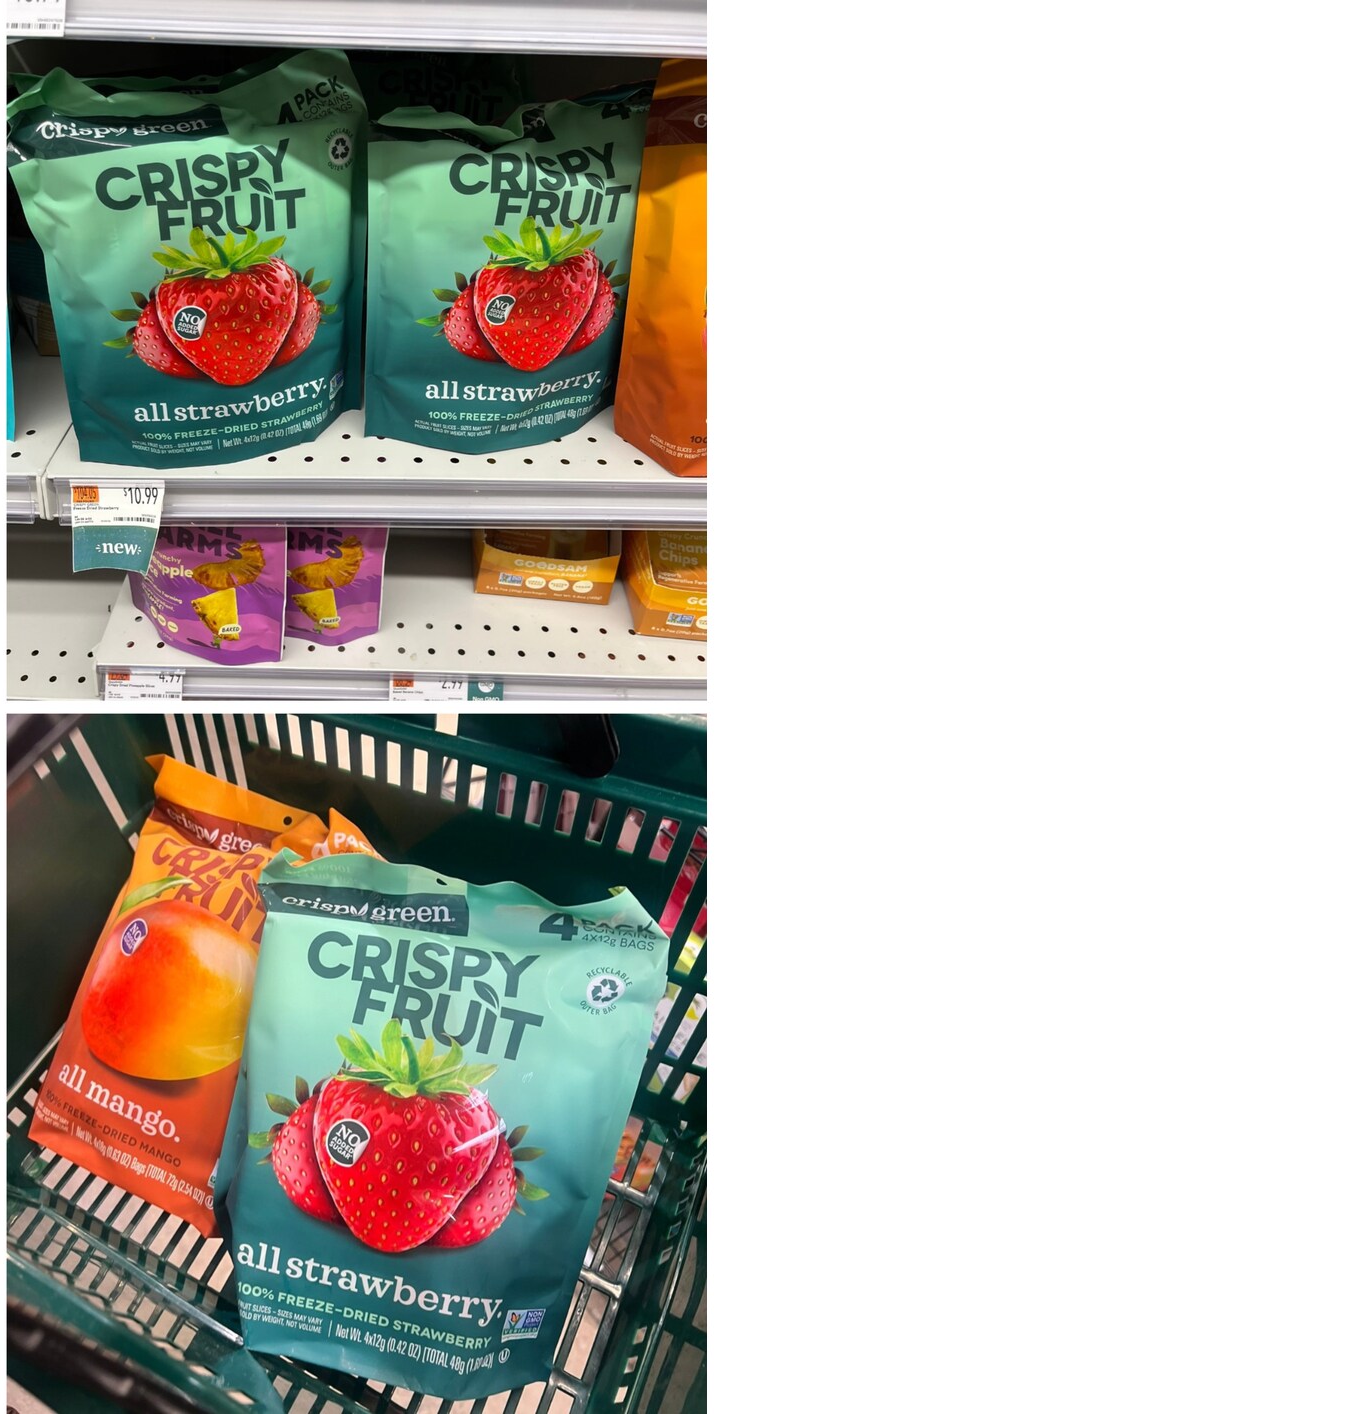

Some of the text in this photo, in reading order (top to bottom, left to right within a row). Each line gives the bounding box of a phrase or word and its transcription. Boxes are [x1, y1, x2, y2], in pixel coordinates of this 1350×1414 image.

[294, 75, 344, 111] PACK
[95, 138, 290, 210] CRISPY
[449, 142, 615, 195] CRISPY
[156, 188, 306, 241] FRUIT
[494, 184, 631, 228] FRUIT
[179, 311, 200, 325] NO
[492, 299, 510, 311] NO
[134, 402, 171, 422] all
[174, 377, 327, 422] strawberry.
[425, 370, 601, 402] all strawberry.
[142, 432, 172, 440] 100%
[261, 401, 323, 429] STRAWBERRY
[428, 411, 457, 420] 100%
[535, 394, 594, 412] STRAWBERRY
[123, 487, 158, 505] $10.99
[102, 541, 138, 555] new
[659, 549, 698, 566] Chips
[539, 913, 579, 941] 4
[620, 939, 654, 951] BAGS
[307, 931, 541, 998] CRISPY
[586, 967, 633, 987] RECYCLABLE
[352, 976, 544, 1061] FRUIT
[580, 1000, 617, 1016] OUTER BAG
[58, 1063, 87, 1094] all
[85, 1080, 181, 1143] mango.
[332, 1136, 354, 1154] ADDED
[336, 1124, 360, 1147] NO
[139, 1142, 181, 1168] MANGO
[166, 1173, 178, 1191] 72g
[237, 1242, 503, 1327] all strawberry.
[238, 1281, 274, 1300] 100%
[392, 1320, 492, 1350] STRAWBERRY
[252, 1303, 323, 1326] SLICES SIZES MAY VARY
[253, 1313, 261, 1321] BY
[285, 1320, 297, 1329] NOT
[298, 1323, 322, 1334] VOLUME
[335, 1323, 349, 1339] Net
[364, 1331, 385, 1353] 4x12g
[387, 1336, 407, 1357] (0.42
[408, 1342, 422, 1362] OZ)
[449, 1355, 465, 1375] 48g
